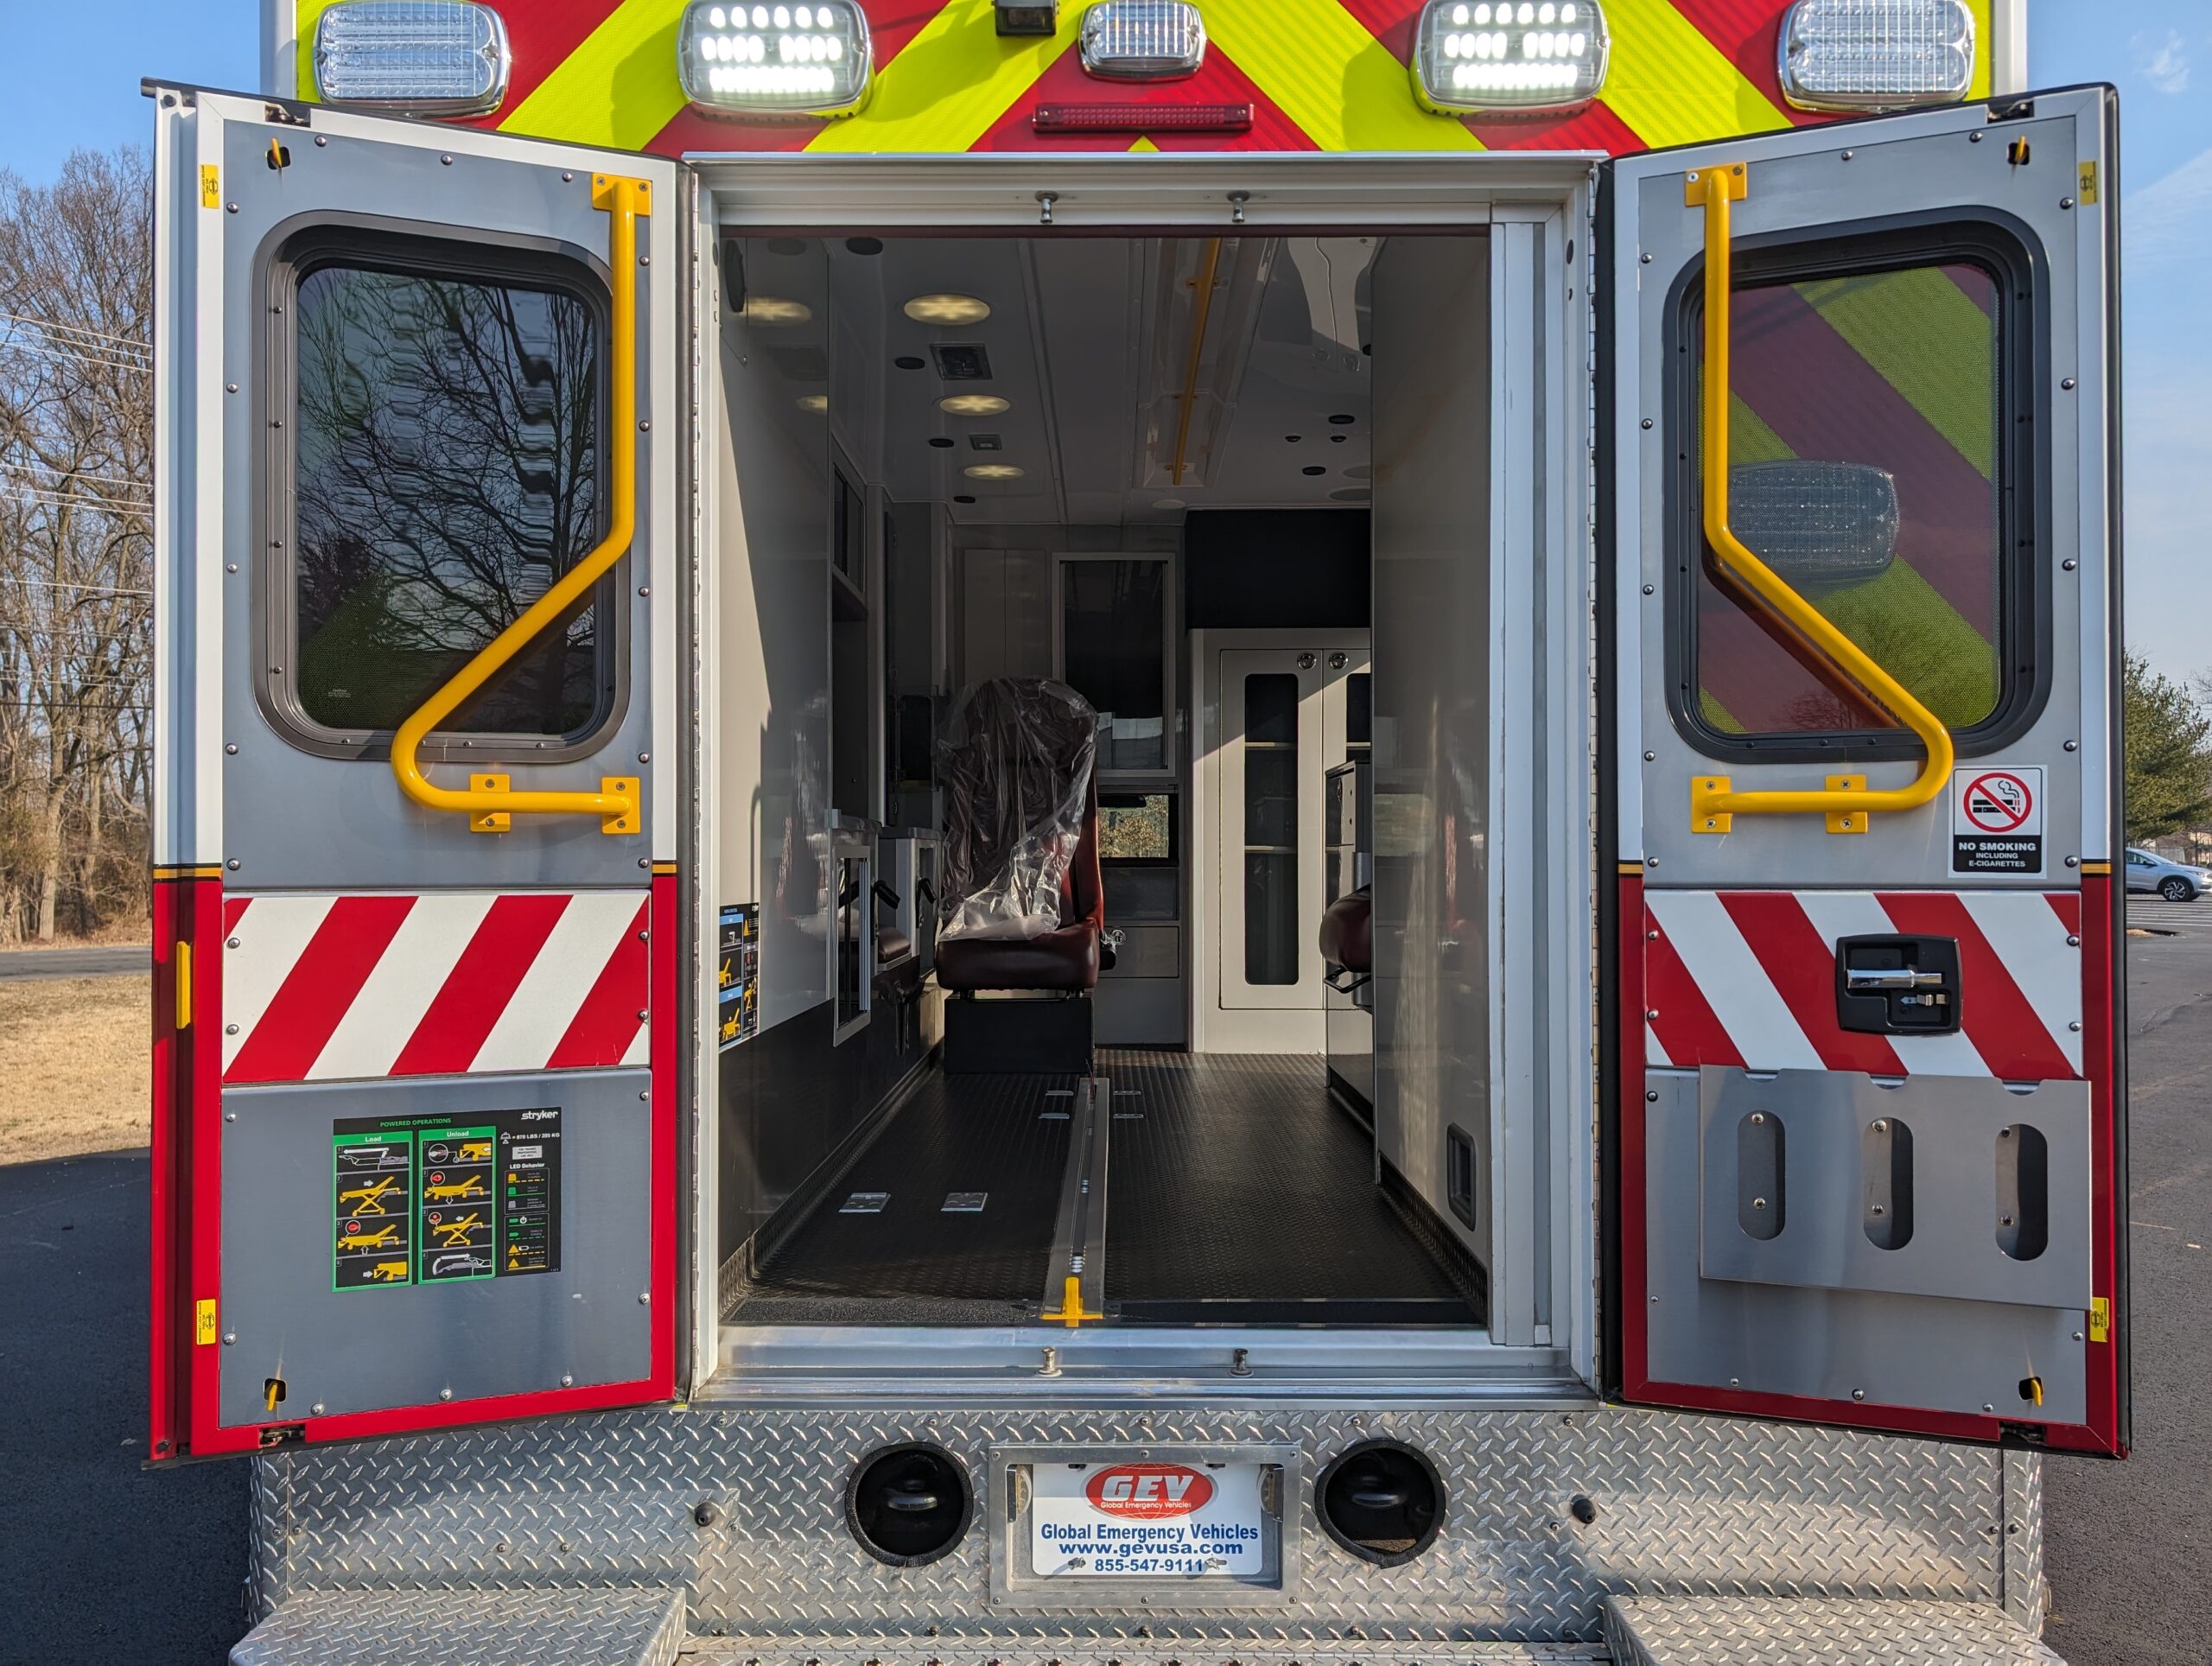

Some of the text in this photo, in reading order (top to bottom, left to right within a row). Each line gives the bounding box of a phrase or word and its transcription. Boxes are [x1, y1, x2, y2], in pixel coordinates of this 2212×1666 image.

[1958, 842, 2036, 851] NO SMOKING
[412, 1117, 452, 1126] OPERATIONS
[520, 1110, 559, 1121] stryker
[1100, 1474, 1194, 1502] GEV
[1100, 1501, 1123, 1510] Global
[1124, 1502, 1163, 1510] Emergency
[1041, 1523, 1258, 1543] Global Emergency Vehicles
[1058, 1542, 1243, 1557] www.gevusa.com
[1094, 1558, 1203, 1573] 855-547-9111
